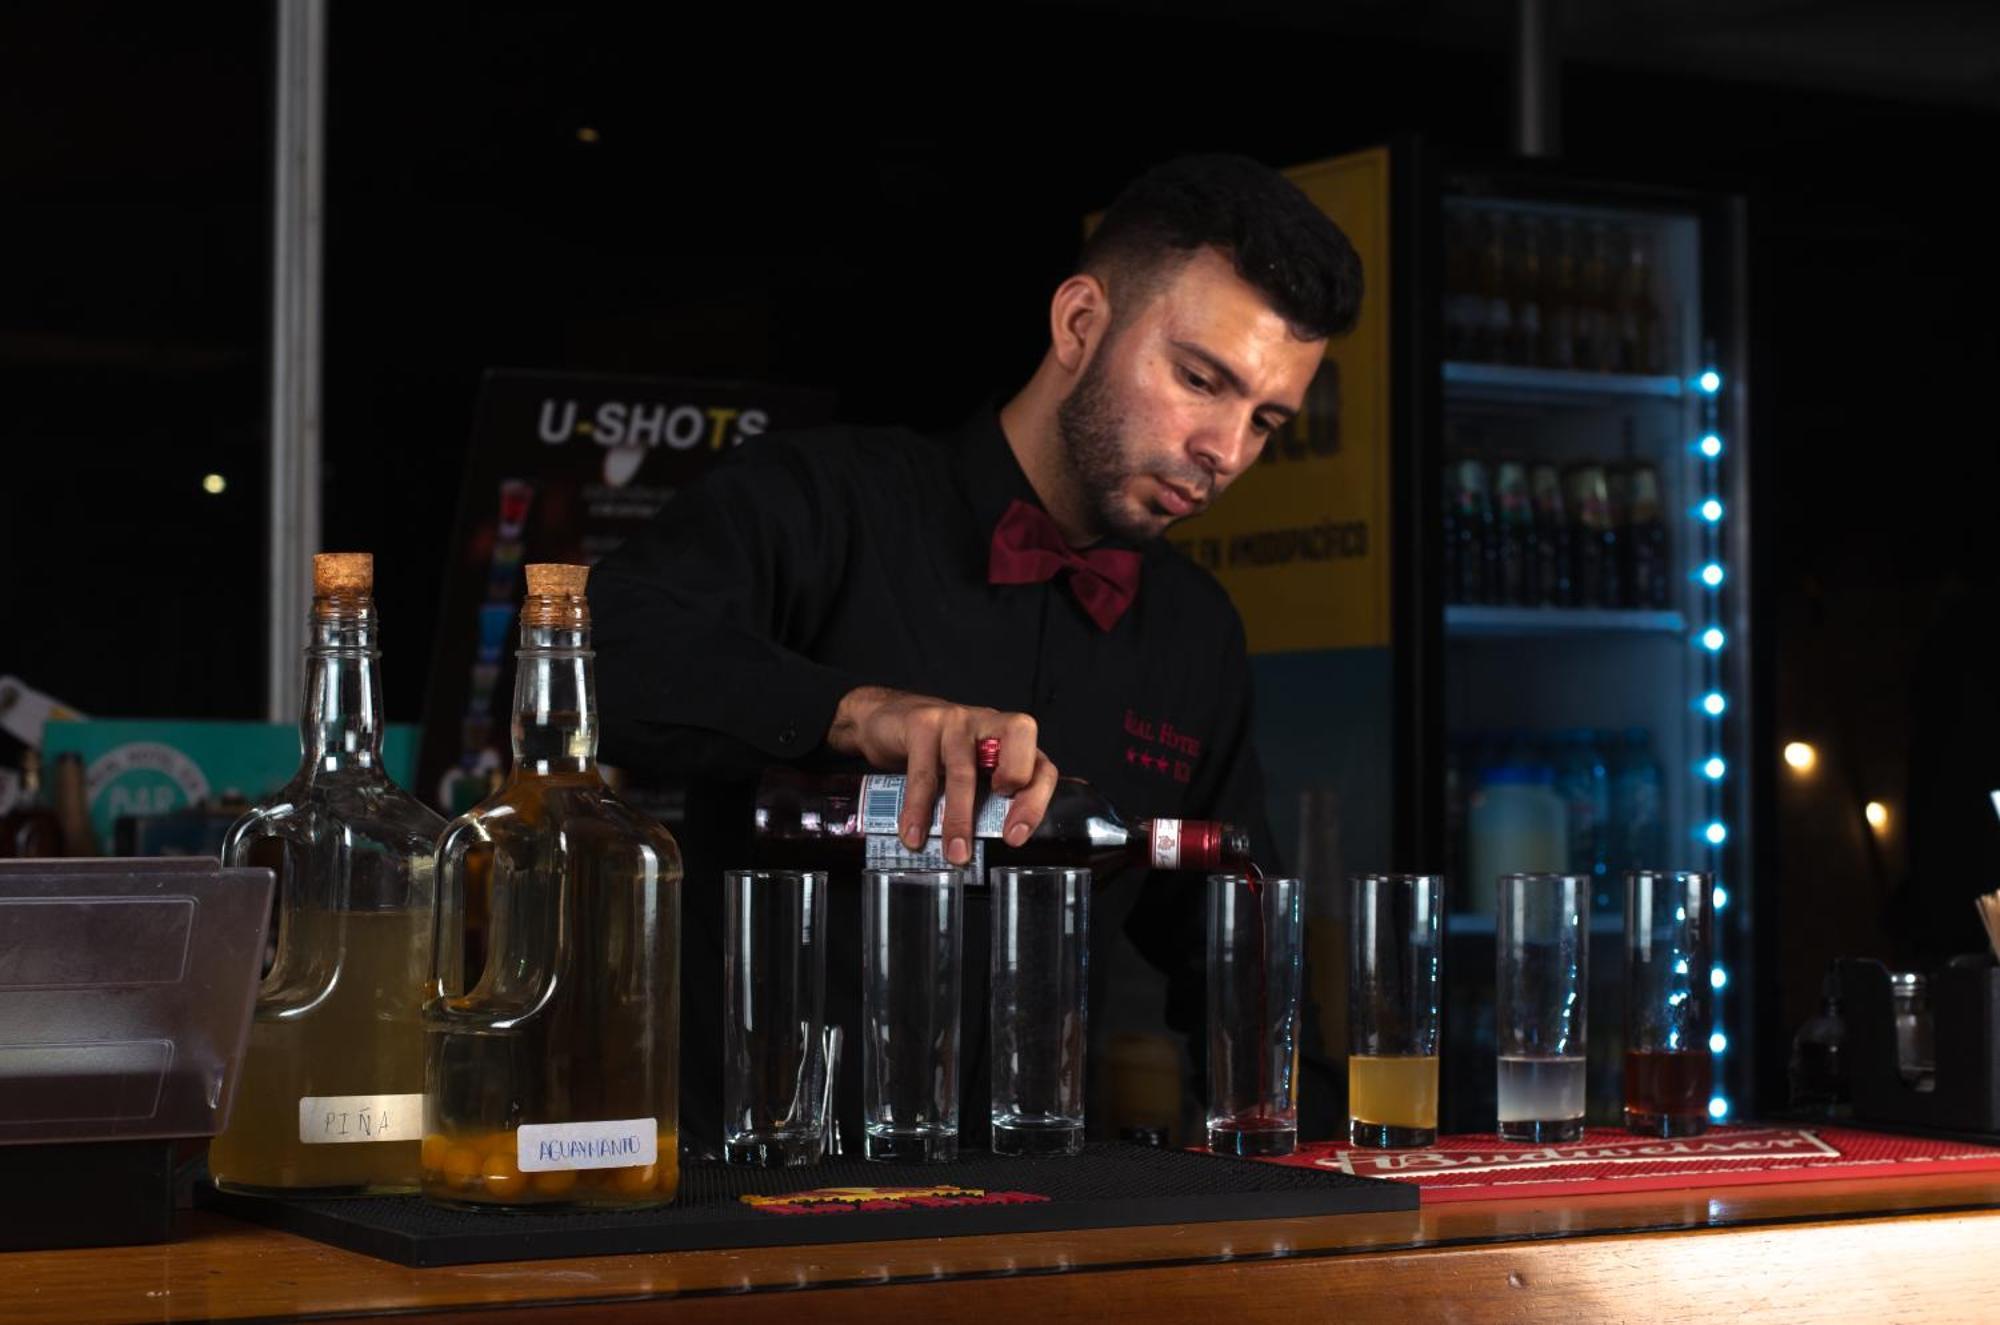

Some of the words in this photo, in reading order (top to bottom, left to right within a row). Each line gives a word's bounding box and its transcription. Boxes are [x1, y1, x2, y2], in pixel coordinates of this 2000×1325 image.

[536, 399, 770, 449] U-SHOTS
[323, 1107, 391, 1137] PIÑA
[1320, 1138, 1803, 1170] Budweiser
